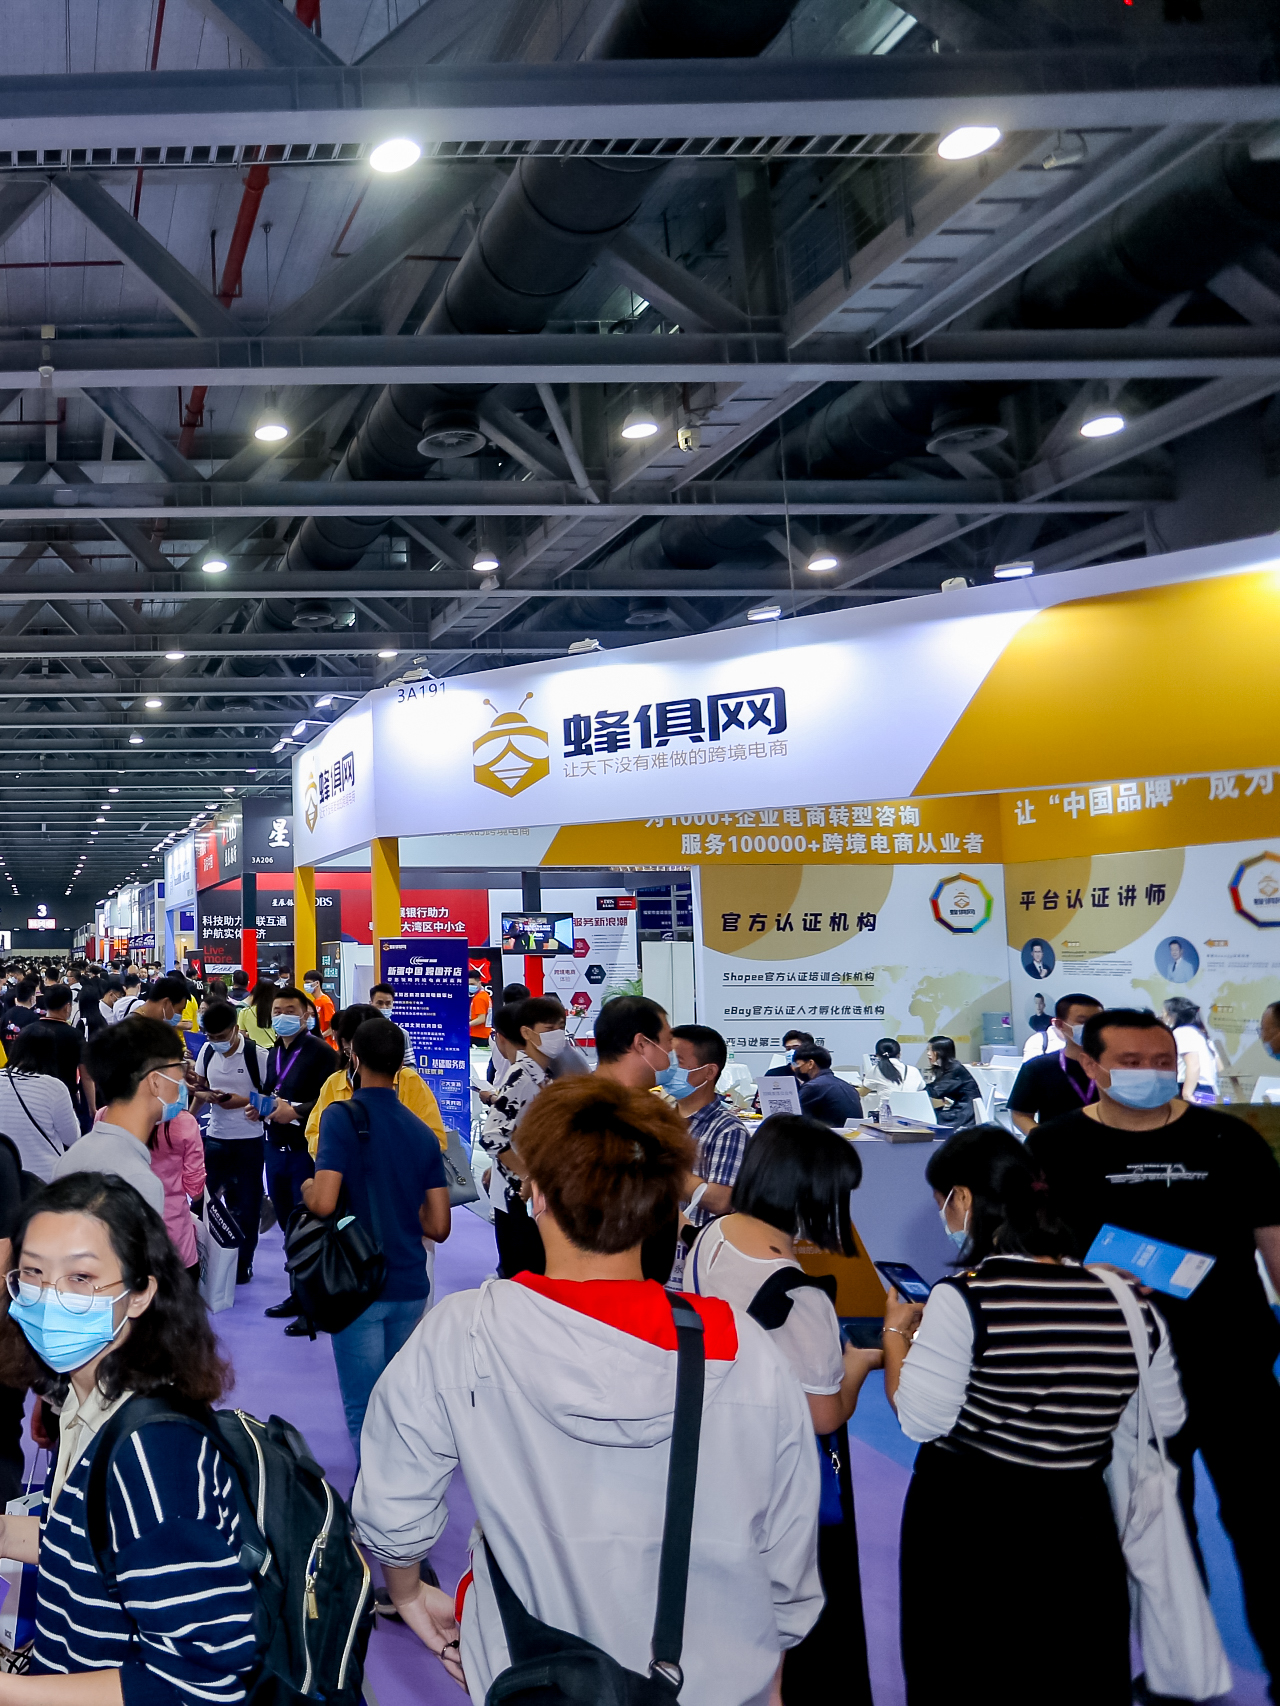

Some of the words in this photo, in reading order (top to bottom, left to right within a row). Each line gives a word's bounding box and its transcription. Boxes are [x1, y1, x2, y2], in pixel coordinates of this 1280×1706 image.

[397, 681, 448, 703] 3A191
[562, 686, 788, 759] 蜂俱网
[563, 739, 788, 779] 让天下没有难做的跨境电商
[318, 750, 355, 804] 蜂俱网
[681, 832, 985, 855] 服务100000+跨境电商从业者
[251, 856, 274, 864] 3A206
[1019, 883, 1167, 911] 平台认证讲师
[721, 911, 877, 932] 官方认证机构
[203, 945, 224, 954] Live
[723, 971, 875, 983] Shopee官方认证培训合作机构
[724, 1005, 885, 1017] eBay官方认证人才孵化优选机构
